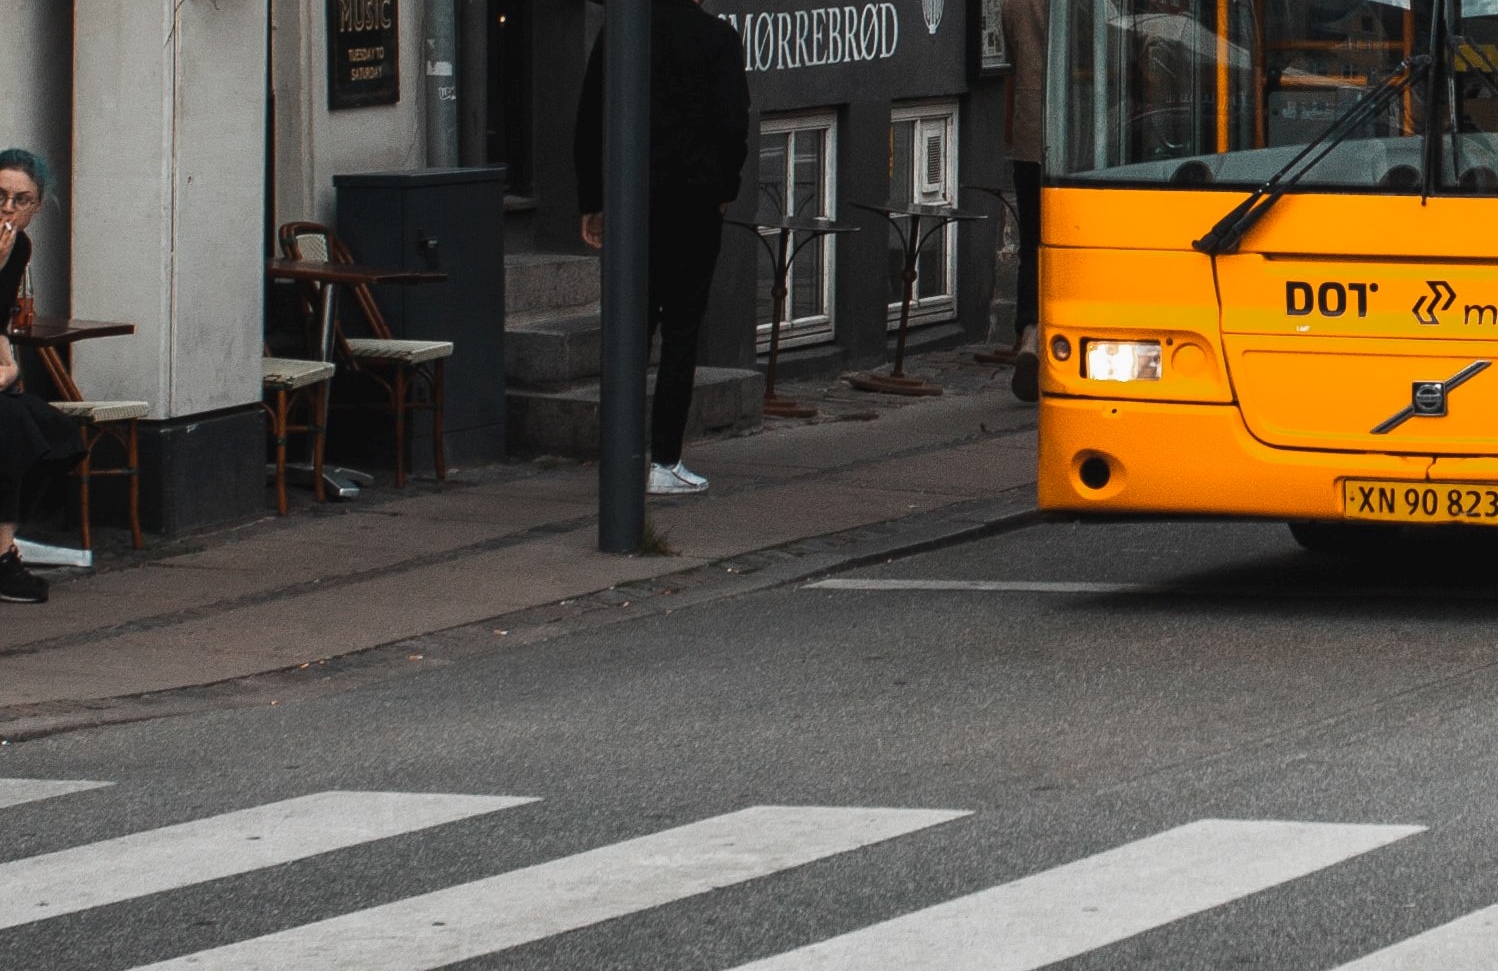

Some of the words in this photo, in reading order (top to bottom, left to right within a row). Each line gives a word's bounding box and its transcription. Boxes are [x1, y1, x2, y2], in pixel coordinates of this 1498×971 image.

[718, 2, 899, 72] MØRREBRØD
[1286, 280, 1379, 318] DOT
[1358, 486, 1396, 514] XN
[1404, 488, 1438, 516] 90
